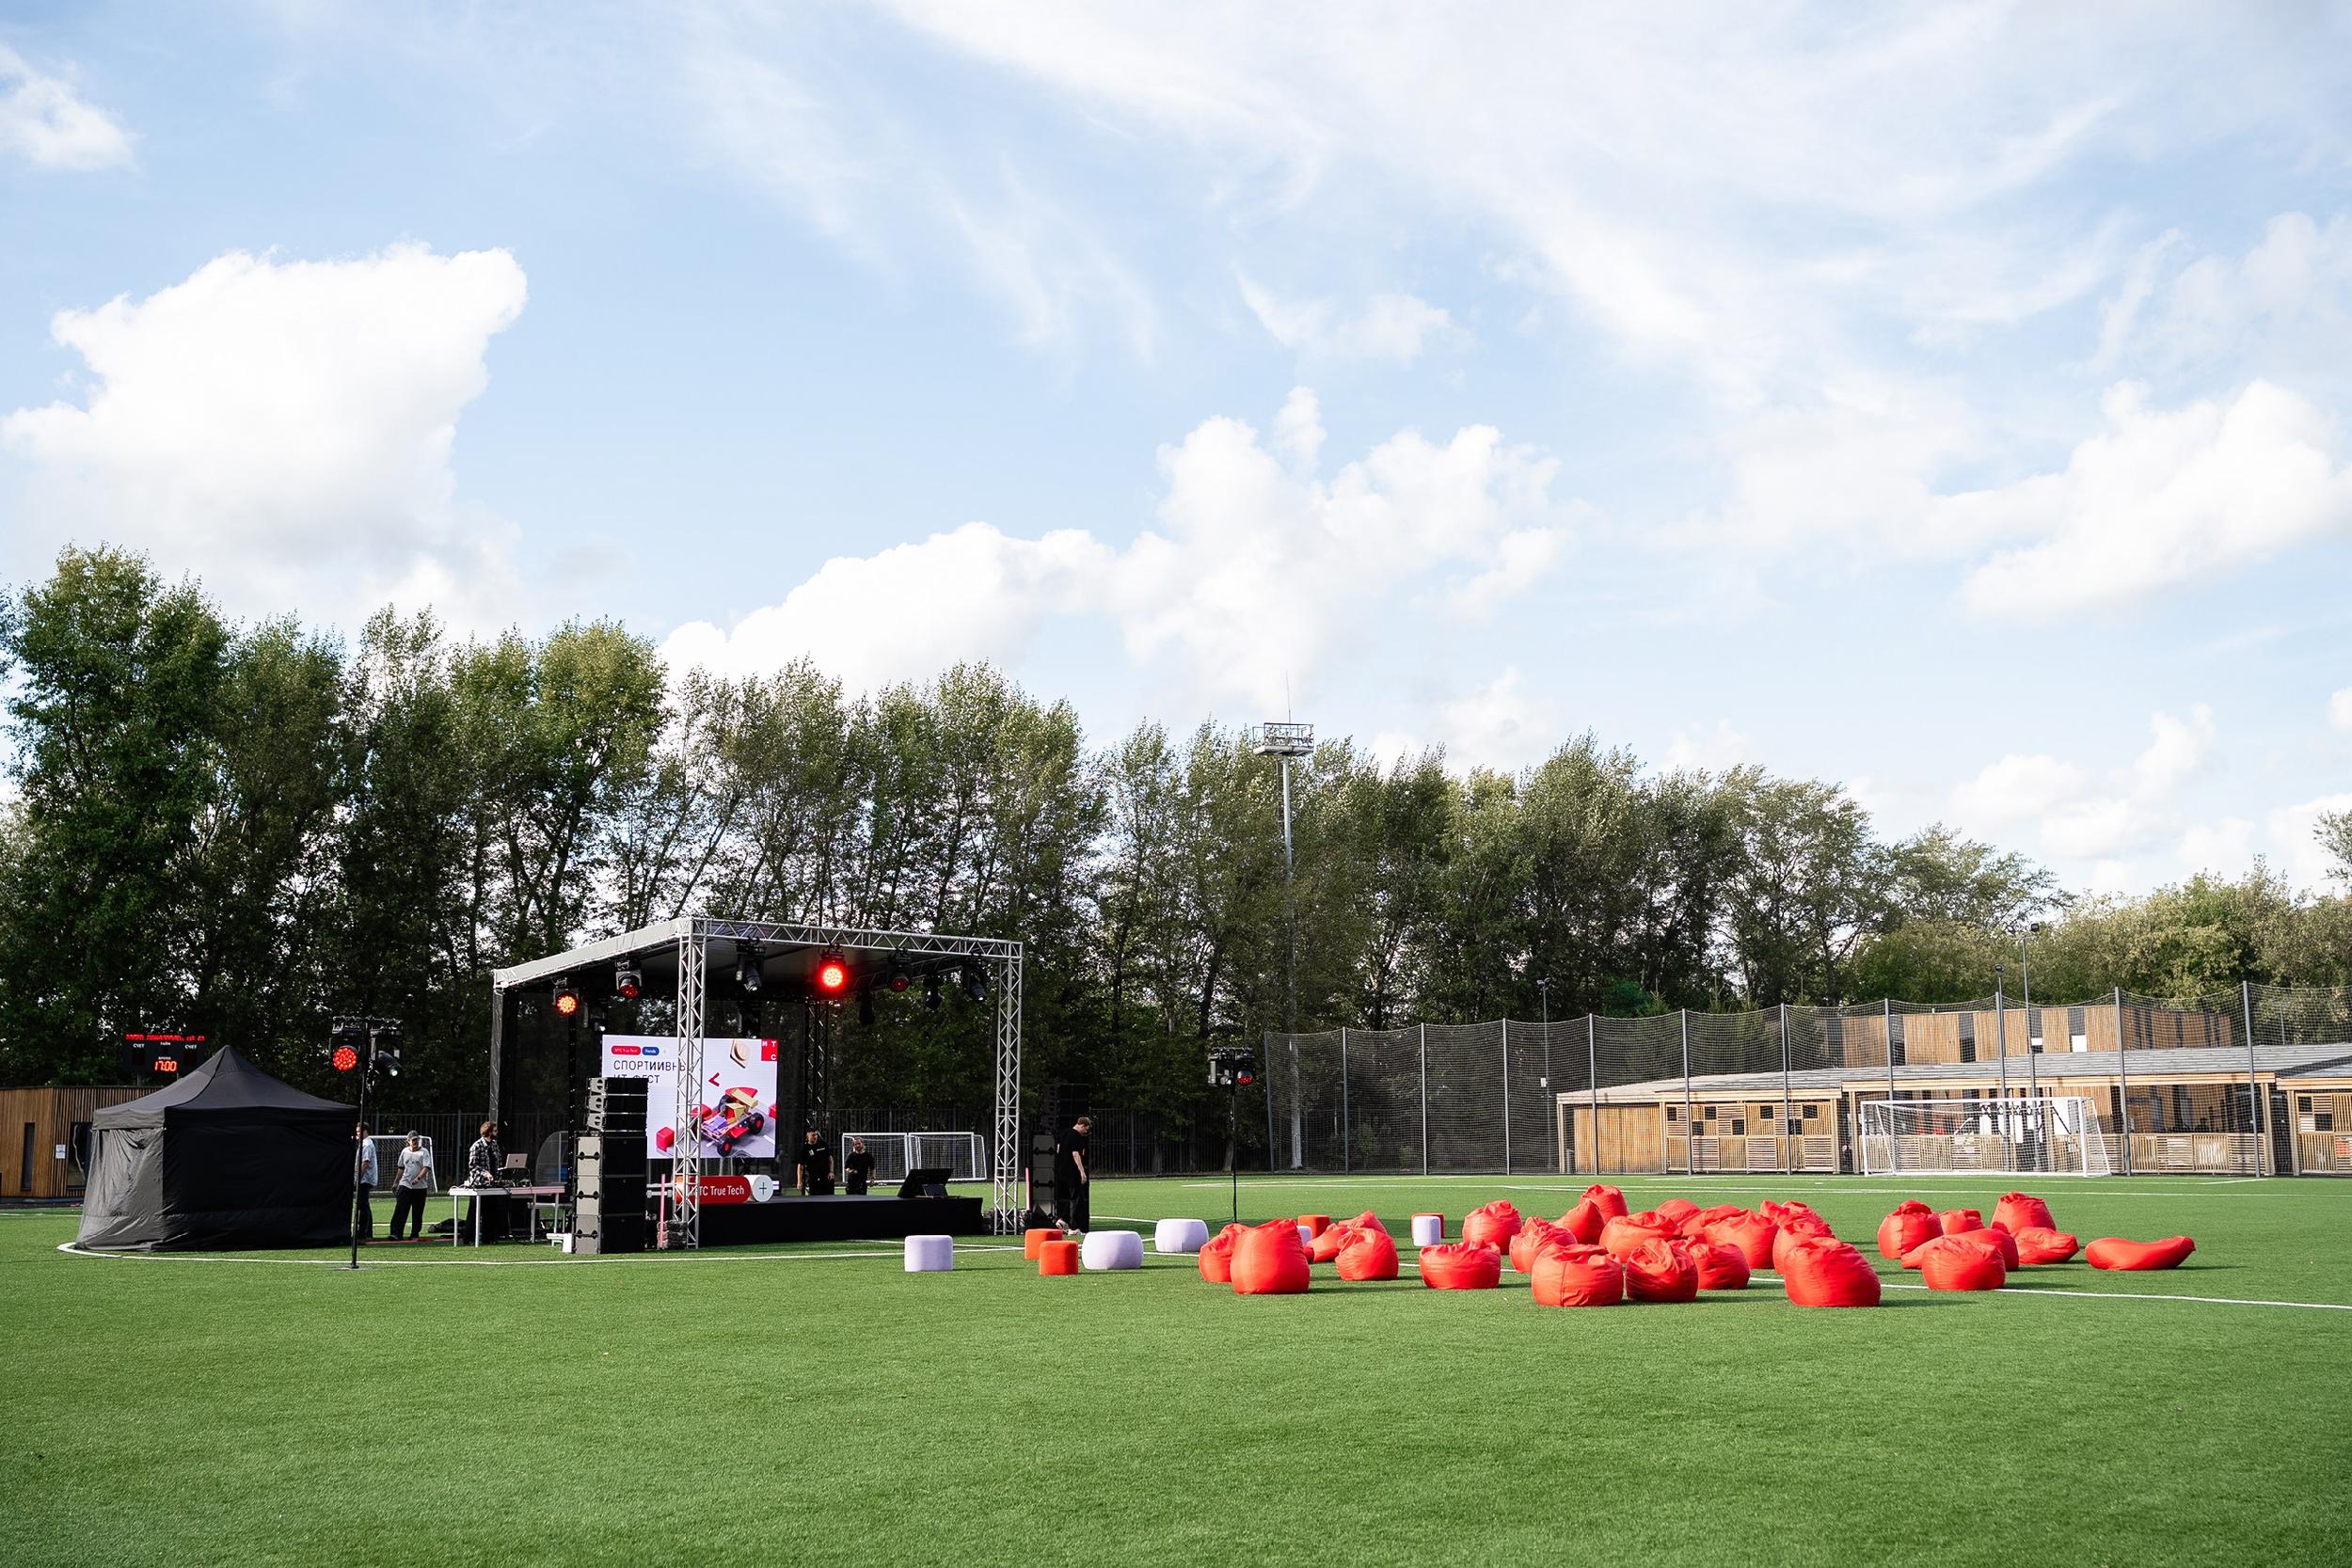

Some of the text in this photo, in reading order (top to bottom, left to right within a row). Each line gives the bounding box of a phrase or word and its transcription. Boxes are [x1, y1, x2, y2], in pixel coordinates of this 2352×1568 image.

[154, 1061, 177, 1071] 17:00
[710, 1185, 725, 1196] True
[727, 1184, 745, 1196] Tech
